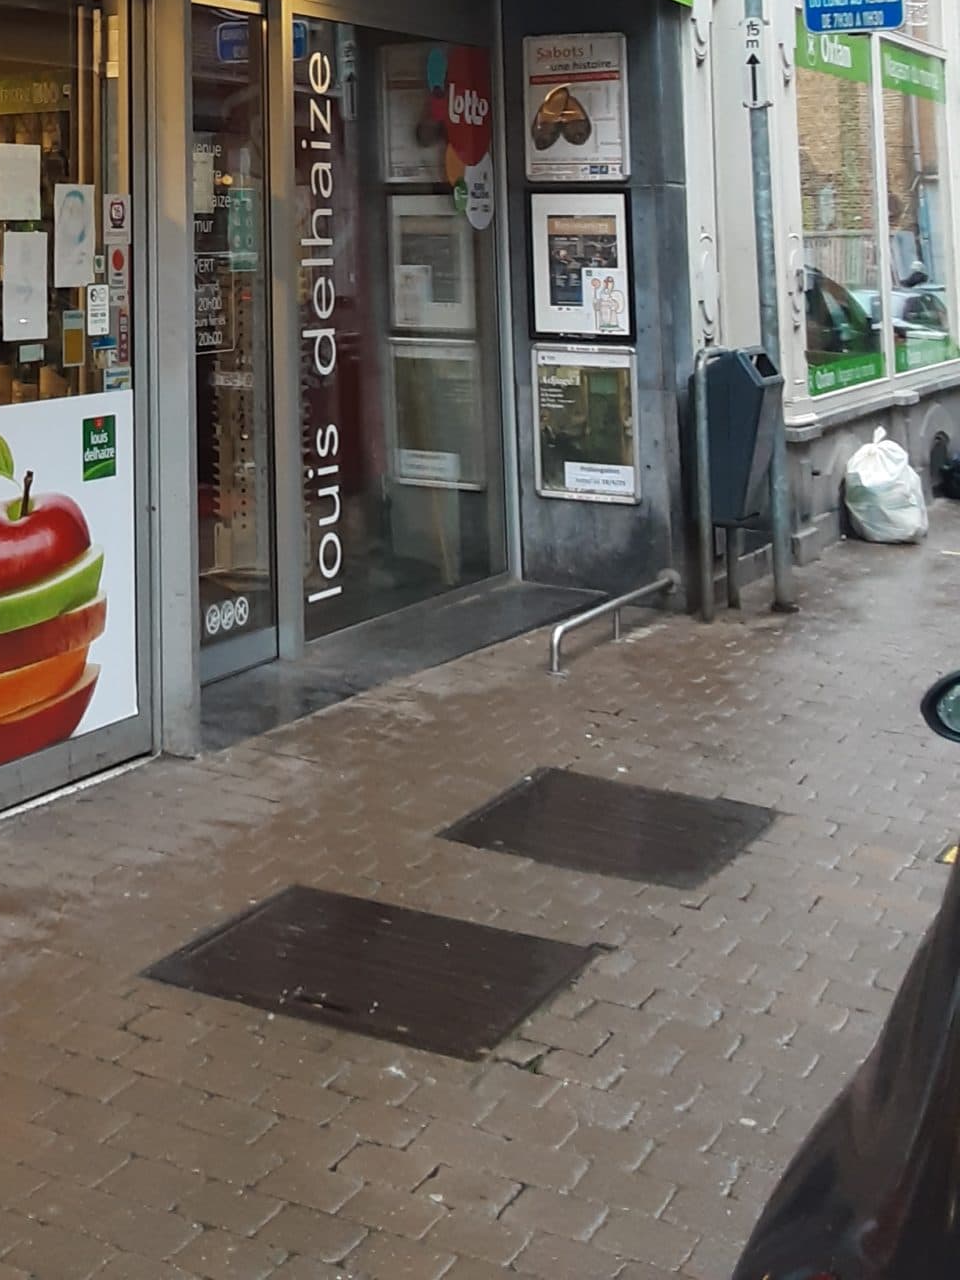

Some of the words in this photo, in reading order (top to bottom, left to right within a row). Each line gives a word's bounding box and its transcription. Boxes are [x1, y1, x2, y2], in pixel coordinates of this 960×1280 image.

[821, 13, 831, 28] DE
[537, 46, 584, 60] Sabots
[301, 49, 337, 376] delhaize
[90, 429, 108, 445] louis
[84, 445, 115, 462] delhaize
[309, 422, 342, 602] louis
